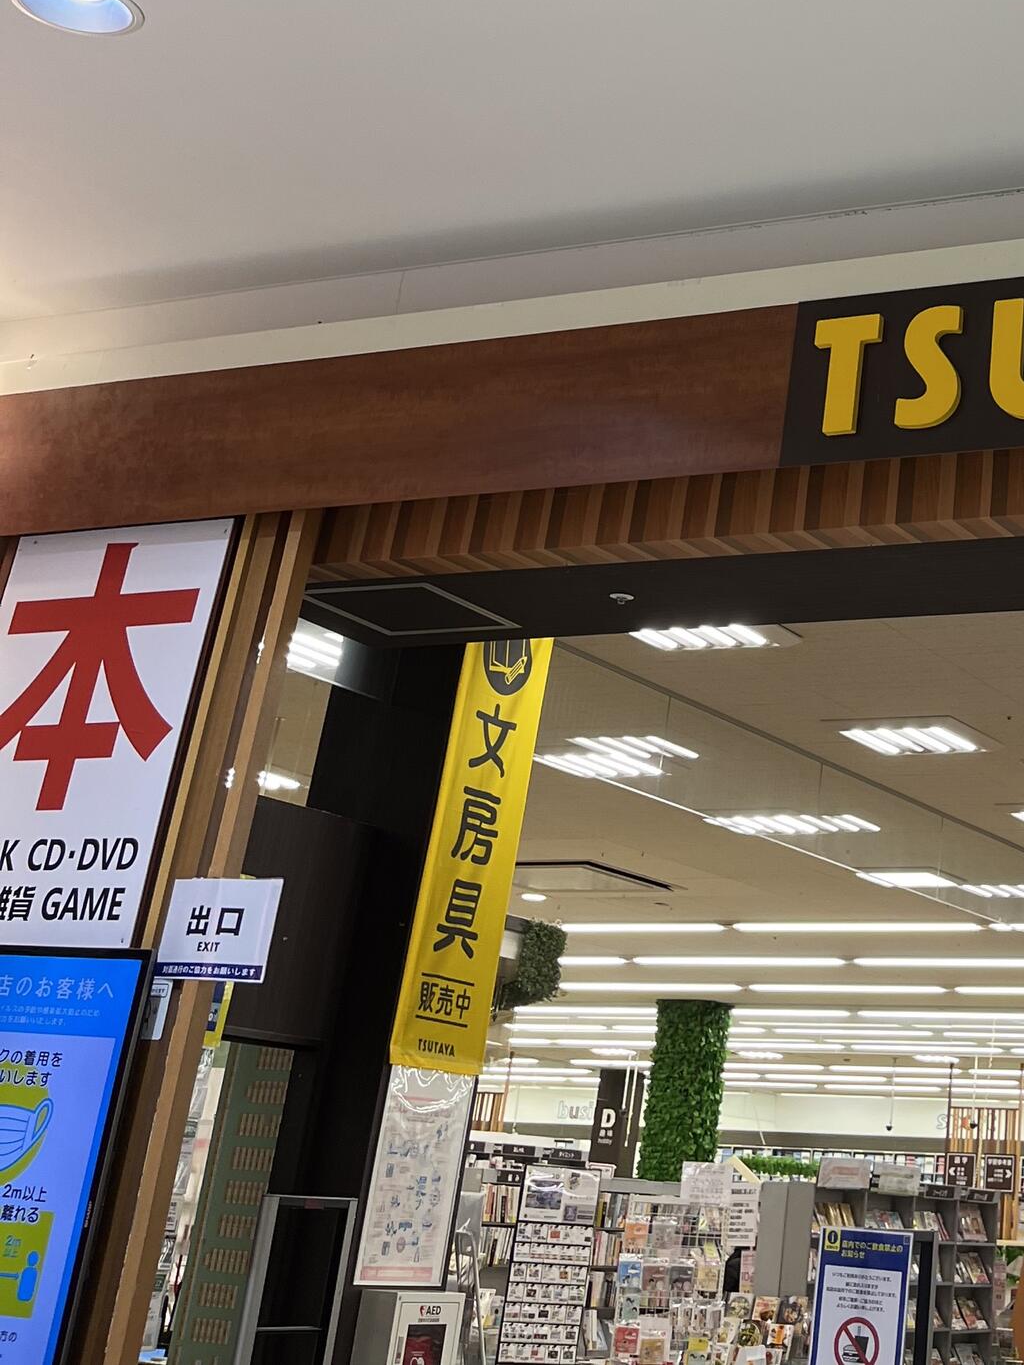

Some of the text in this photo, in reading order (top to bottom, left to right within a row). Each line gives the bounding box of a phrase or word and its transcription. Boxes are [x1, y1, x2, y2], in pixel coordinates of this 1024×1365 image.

[0, 543, 200, 811] 本
[433, 703, 517, 959] 文房具
[41, 887, 126, 921] GAME
[186, 905, 245, 936] 出口
[197, 941, 221, 952] EXIT
[418, 981, 473, 1020] 販売中
[418, 1038, 455, 1058] TSUTAYA
[2, 1184, 47, 1202] 2m以上
[426, 1305, 441, 1315] AED
